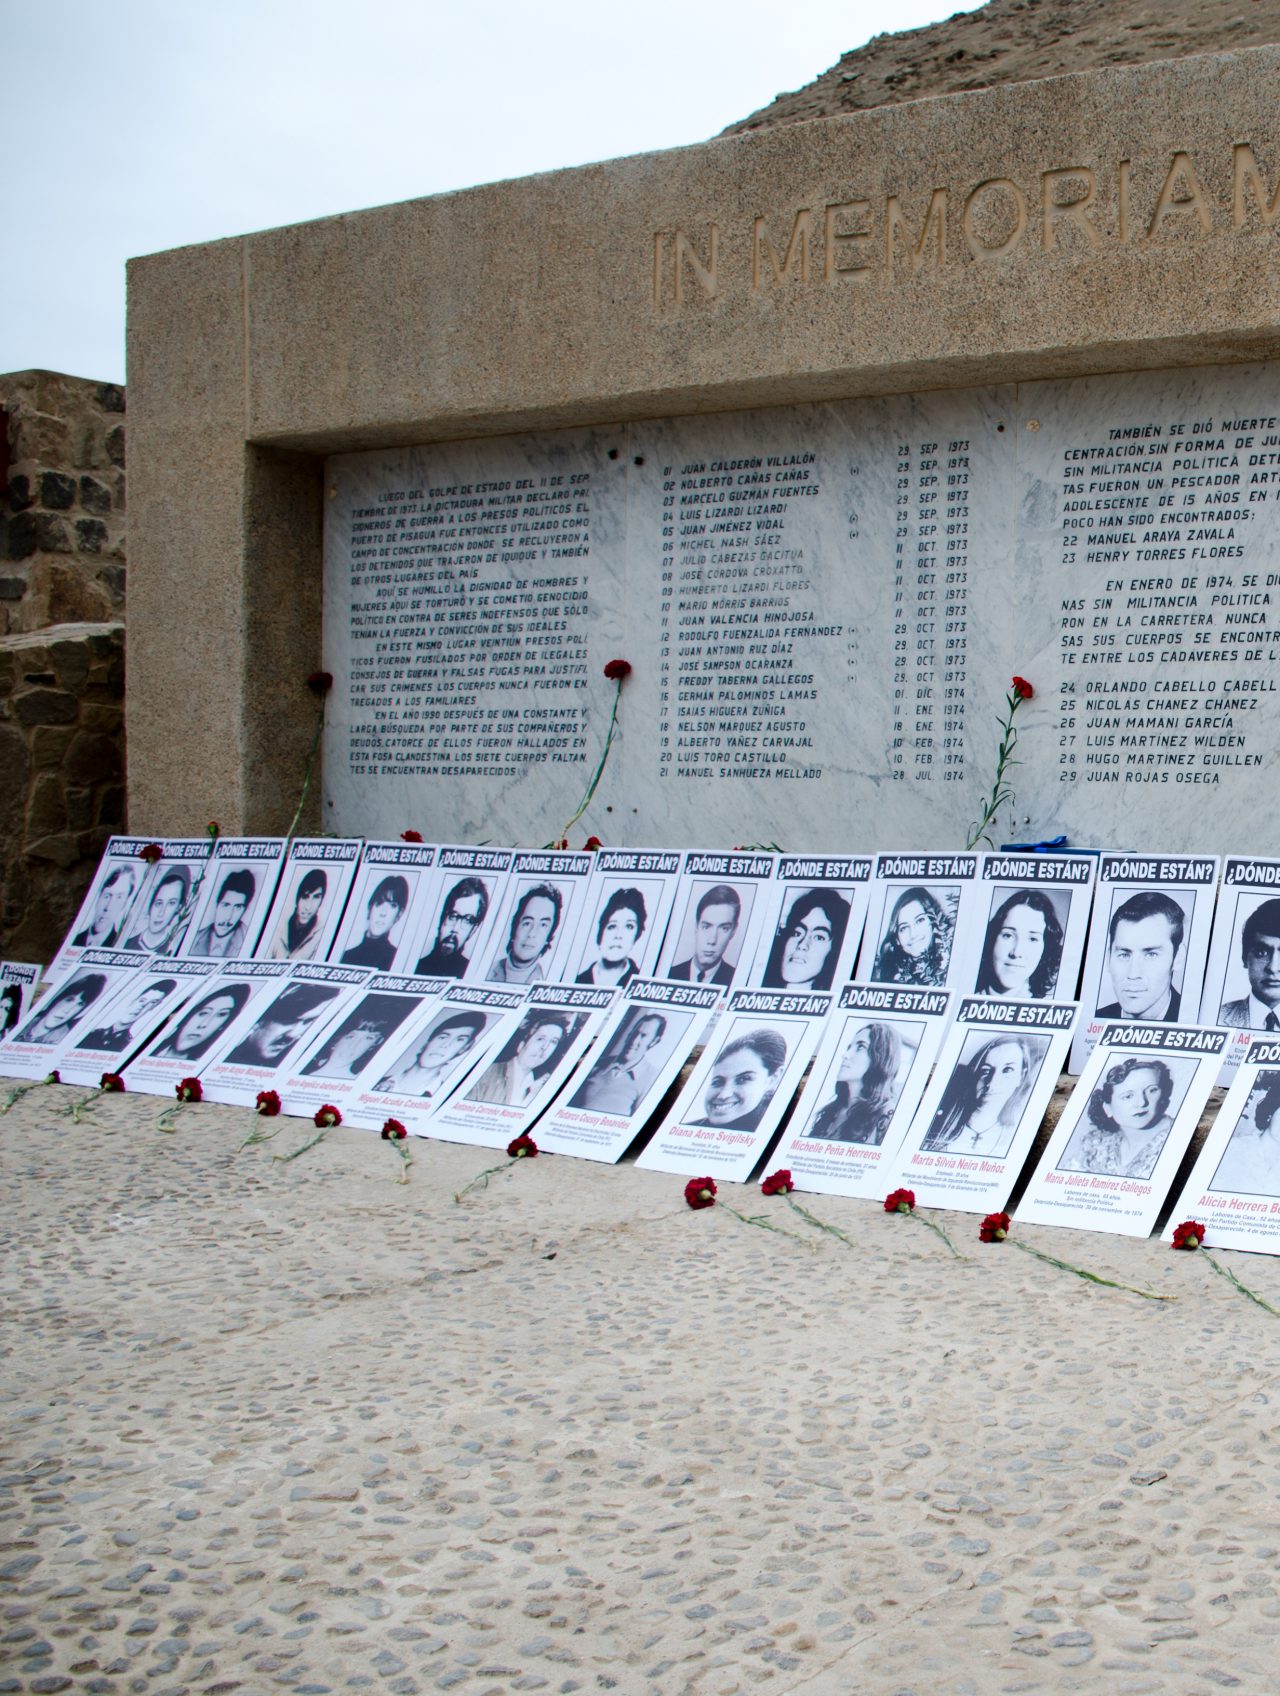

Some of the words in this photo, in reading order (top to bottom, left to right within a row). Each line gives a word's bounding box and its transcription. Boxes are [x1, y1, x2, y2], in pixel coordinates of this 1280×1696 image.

[652, 222, 719, 311] IN
[1063, 535, 1078, 547] 22
[1087, 532, 1137, 546] MANUEL
[1142, 530, 1180, 543] ARAYA
[1186, 527, 1235, 541] ZAVALA
[1060, 682, 1075, 694] 24
[1086, 681, 1147, 693] ORLANDO
[1154, 680, 1216, 692] CABELLO
[350, 697, 393, 707] TREGADOS
[395, 697, 401, 706] A
[404, 696, 422, 706] LOS
[425, 695, 477, 706] FAMILIARES
[1060, 717, 1076, 729] 26
[1086, 717, 1121, 728] JUAN
[1185, 712, 1233, 728] GARCÍA
[660, 752, 672, 762] 20
[677, 752, 700, 763] LUIS
[704, 752, 731, 762] TORO
[734, 752, 787, 763] CASTILLO
[350, 765, 366, 774] TES
[367, 765, 379, 775] SE
[381, 765, 439, 775] ENCUENTRAN
[660, 767, 668, 777] 21
[677, 767, 714, 778] MANUEL
[719, 767, 771, 778] SANHUEZA
[775, 768, 822, 779] MELLADO
[1059, 771, 1077, 782] 29
[1087, 771, 1120, 782] JUAN
[1125, 771, 1169, 783] ROJAS
[1175, 772, 1219, 784] OSEGA
[878, 856, 926, 879] ¿DÓNDE
[928, 856, 975, 875] ESTÁN?
[1103, 858, 1157, 882] ¿DÓNDE
[1160, 859, 1213, 880] ESTÁN?
[729, 995, 780, 1011] ¿DÓNDE
[780, 997, 829, 1013] ESTÁN?
[959, 1000, 1017, 1022] ¿DÓNDE
[1017, 1005, 1073, 1025] ESTÁN?
[668, 1126, 694, 1138] Diana
[693, 1129, 716, 1141] Aron
[793, 1140, 821, 1153] Michelle
[826, 1144, 844, 1156] Peña
[847, 1148, 880, 1160] Herreros
[911, 1154, 934, 1166] Marta
[979, 1161, 1005, 1174] Muñoz
